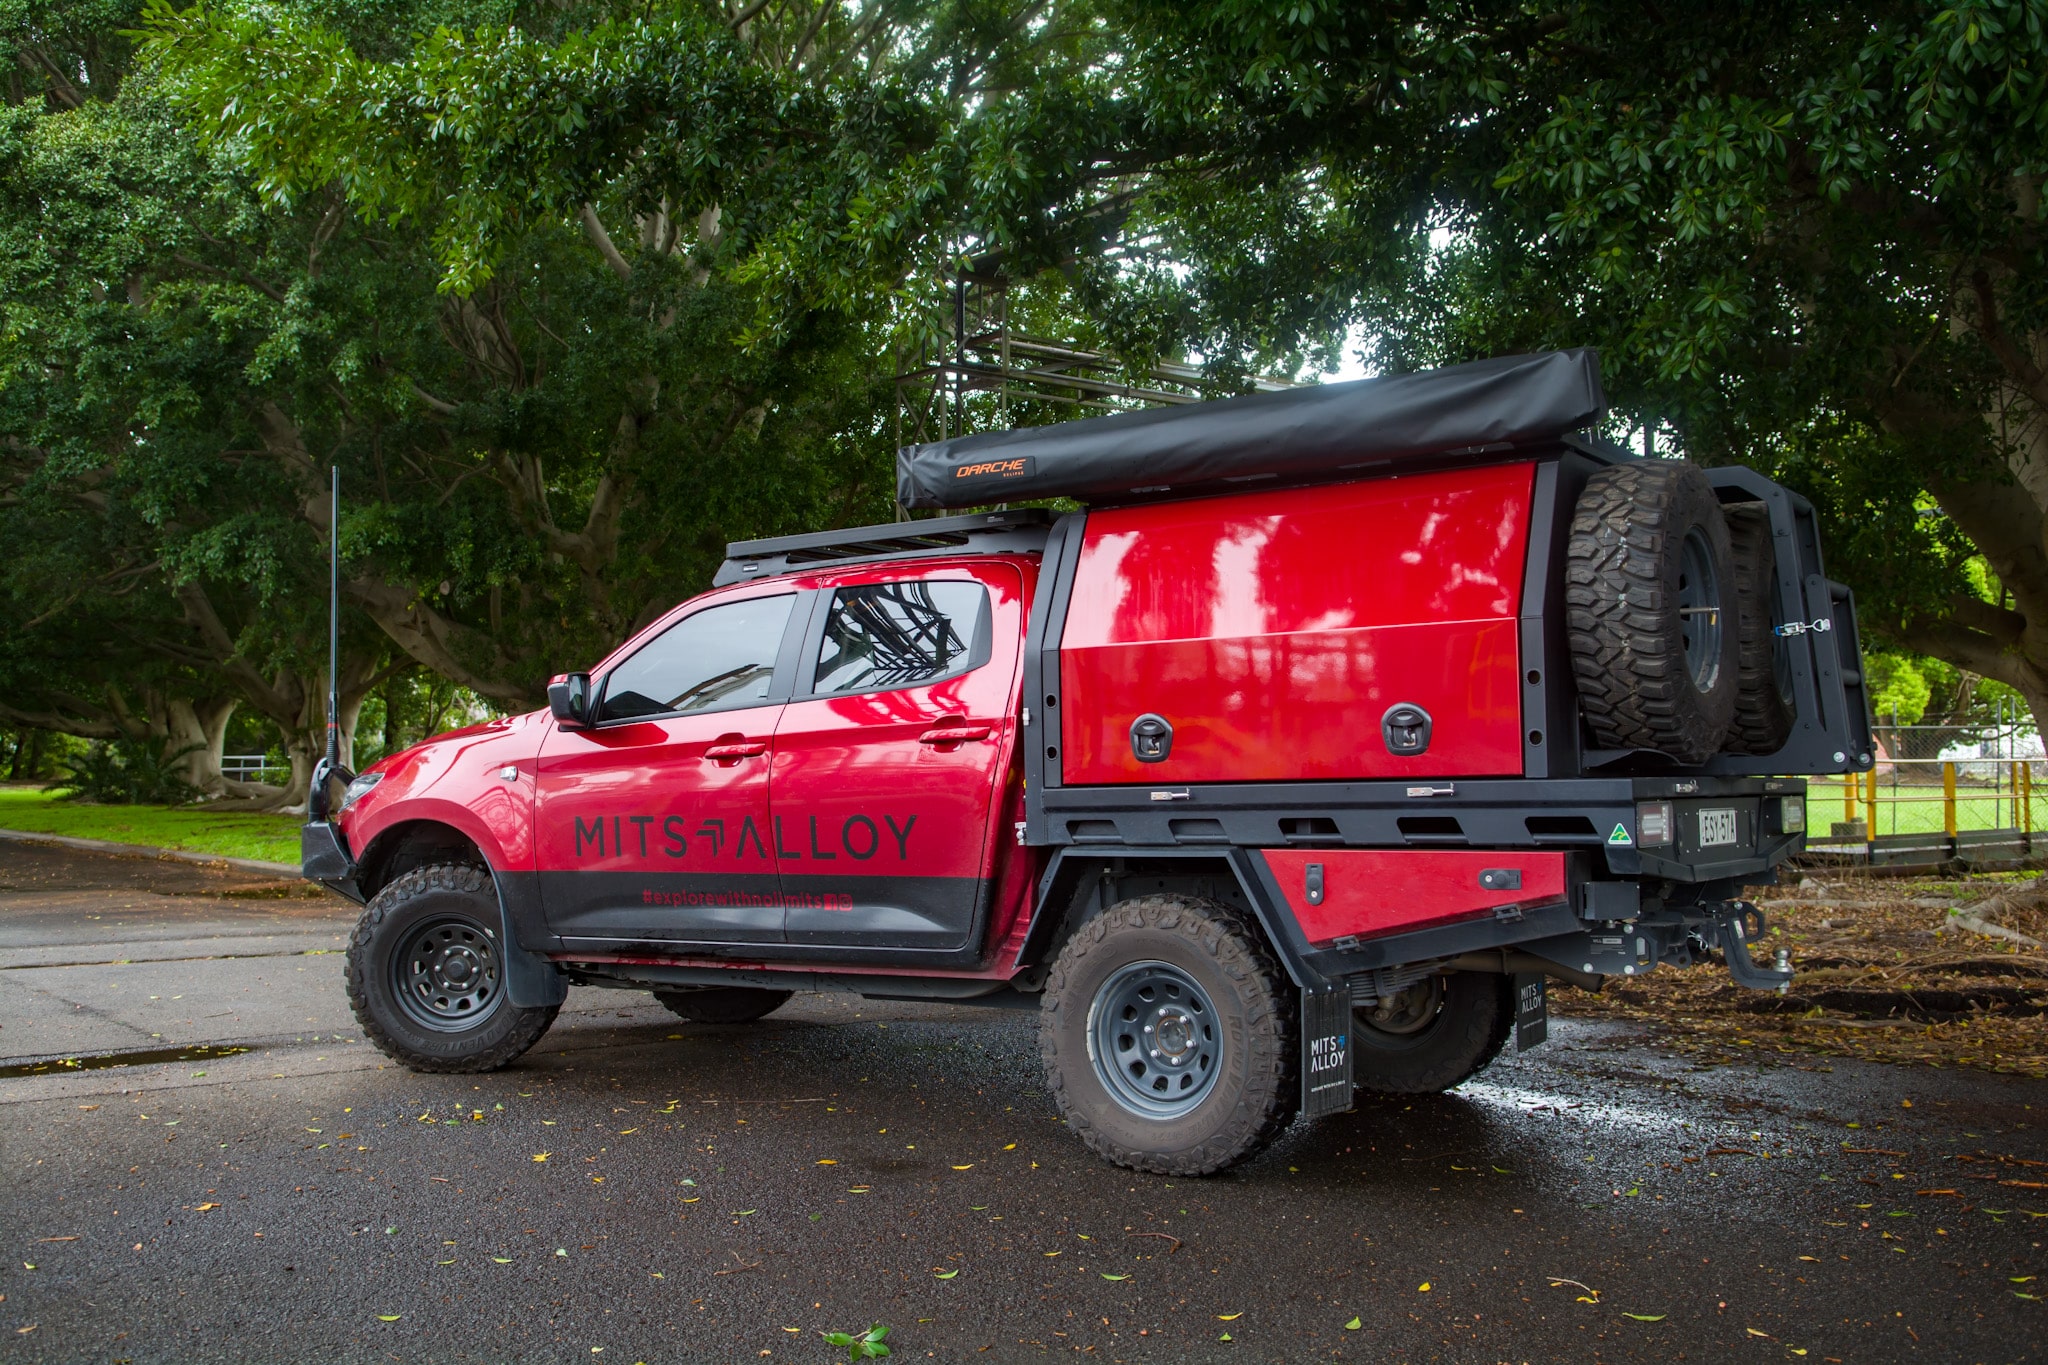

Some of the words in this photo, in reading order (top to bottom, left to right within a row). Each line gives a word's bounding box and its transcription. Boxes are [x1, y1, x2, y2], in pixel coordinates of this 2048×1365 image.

[955, 458, 1027, 478] DARCHE
[574, 814, 688, 858] MITS
[736, 814, 919, 861] ALLOY
[642, 888, 822, 908] #explorewithnolimits
[1521, 983, 1537, 1000] MITS
[1521, 995, 1542, 1014] ALLOY
[1311, 1036, 1337, 1056] MITS
[1311, 1050, 1345, 1073] ALLOY
